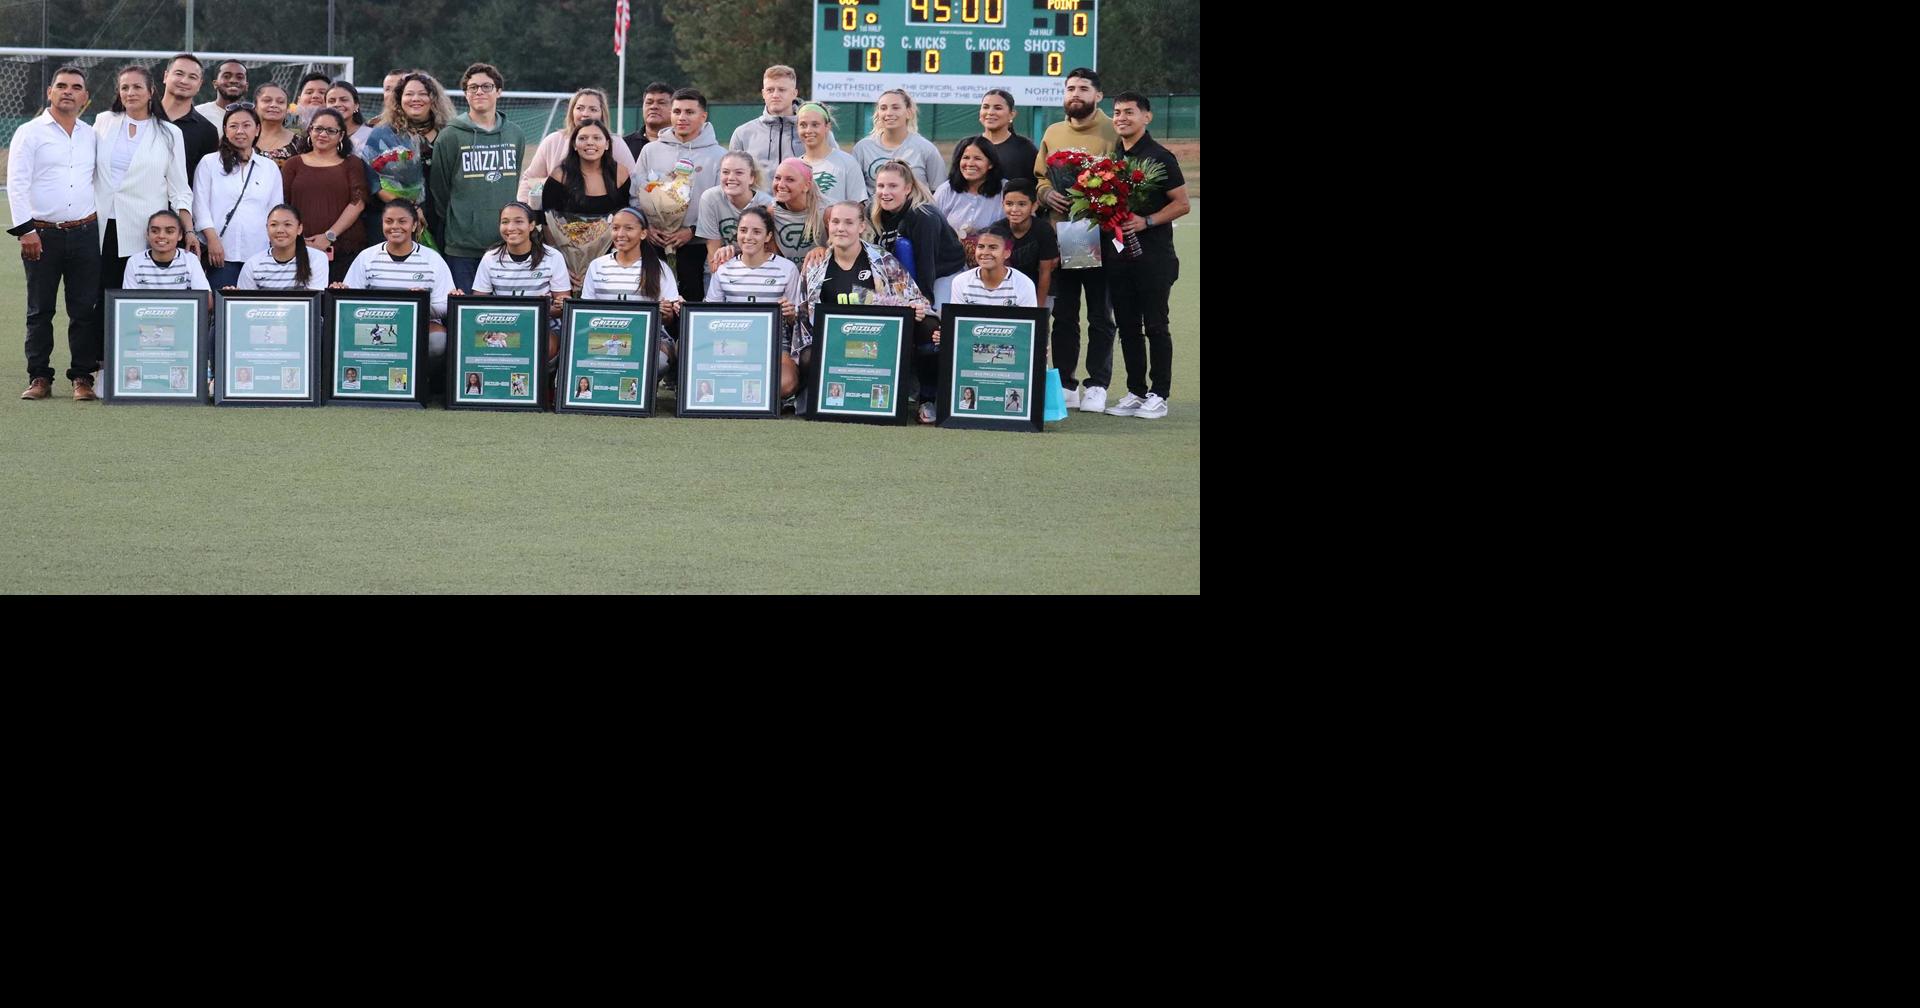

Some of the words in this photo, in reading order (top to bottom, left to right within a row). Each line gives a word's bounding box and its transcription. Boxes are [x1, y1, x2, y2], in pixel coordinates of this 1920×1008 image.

[911, 0, 1002, 23] 45:00
[842, 7, 857, 31] 0
[1073, 13, 1088, 36] 0
[843, 35, 885, 48] SHOTS
[901, 37, 912, 49] C.
[915, 37, 946, 49] KICKS
[965, 38, 976, 50] C.
[979, 38, 1010, 51] KICKS
[1024, 39, 1066, 52] SHOTS
[866, 48, 881, 72] 0
[925, 49, 940, 73] 0
[989, 51, 1004, 75] 0
[1047, 52, 1062, 76] 0
[817, 83, 884, 92] NORTHSIDE
[1024, 87, 1065, 96] NORTH
[462, 150, 517, 172] GRIZZLIES
[476, 313, 518, 323] GRIZZLIES
[590, 317, 629, 327] GRIZZLIES
[842, 323, 882, 332] GRIZZLIES
[973, 325, 1014, 335] GRIZZLIES
